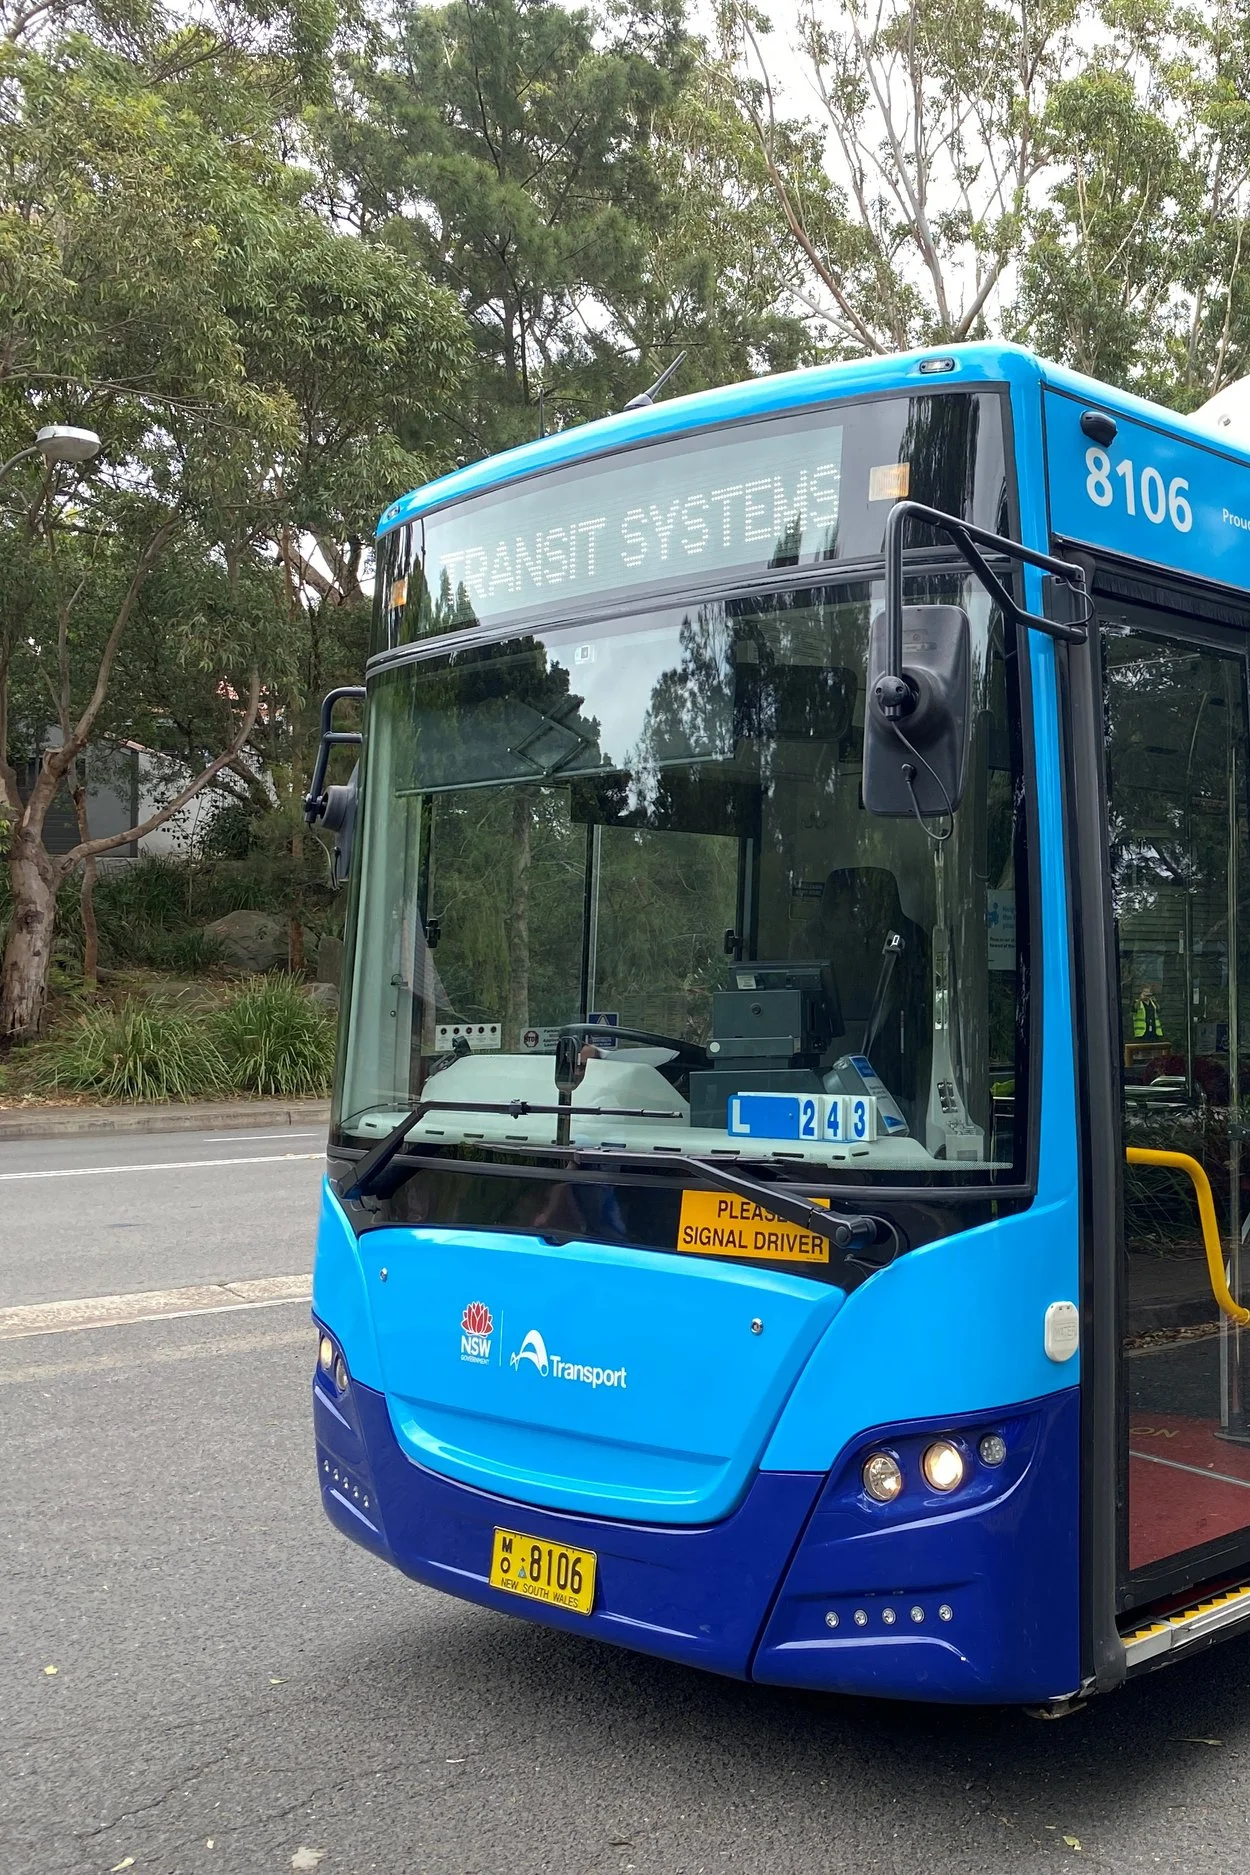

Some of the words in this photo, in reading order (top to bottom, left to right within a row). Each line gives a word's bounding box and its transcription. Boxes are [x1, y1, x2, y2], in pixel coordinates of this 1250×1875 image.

[1085, 447, 1193, 533] 8106
[440, 517, 606, 605] TRANSIT
[621, 463, 842, 568] SYSTEMS
[732, 1099, 750, 1134] L
[717, 1199, 788, 1223] PLEAS
[683, 1225, 749, 1249] SIGNAL
[753, 1231, 824, 1255] DRIVER
[460, 1335, 491, 1358] NSW
[550, 1355, 627, 1389] Transport
[529, 1544, 583, 1594] 8106
[501, 1577, 519, 1590] NEW
[522, 1583, 549, 1599] SOUTH
[552, 1591, 579, 1608] WALES
